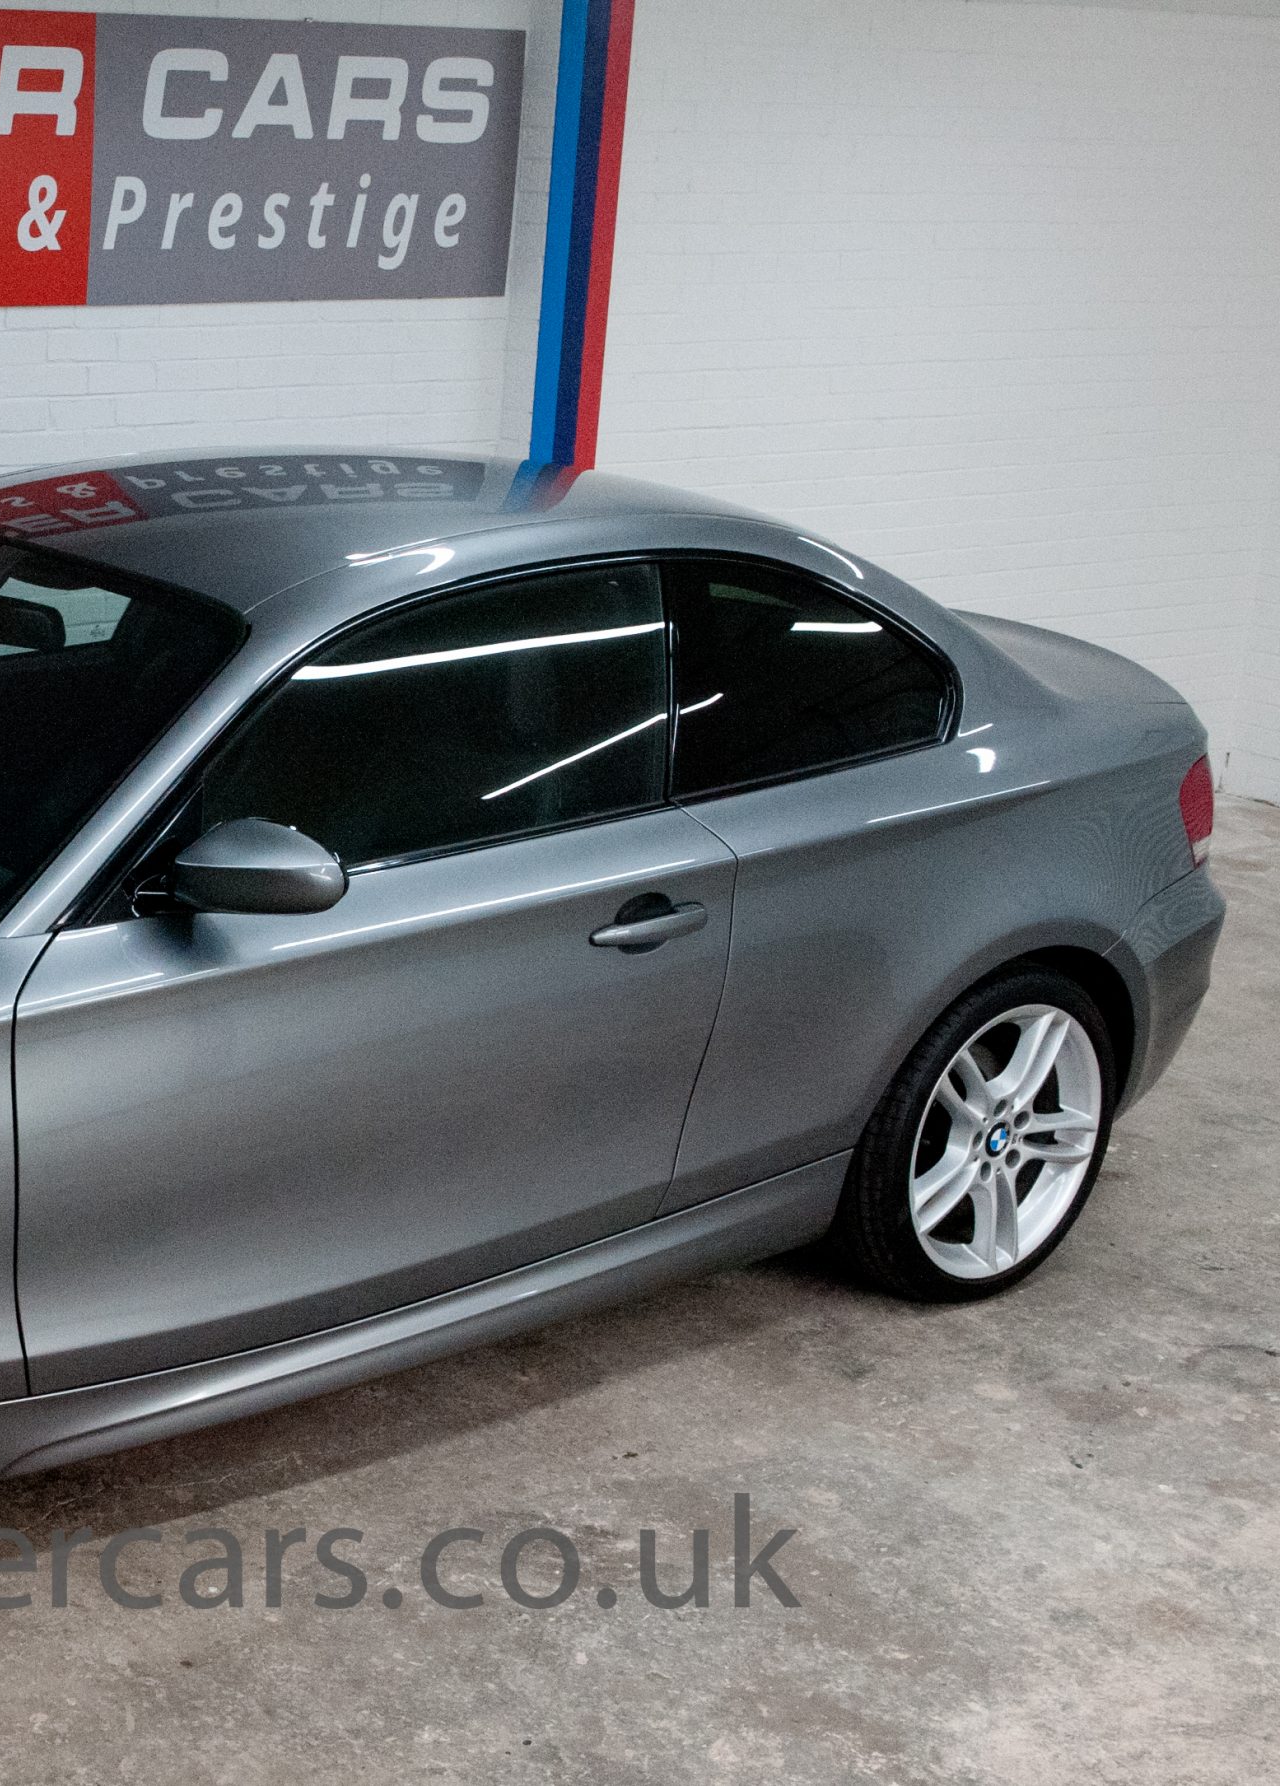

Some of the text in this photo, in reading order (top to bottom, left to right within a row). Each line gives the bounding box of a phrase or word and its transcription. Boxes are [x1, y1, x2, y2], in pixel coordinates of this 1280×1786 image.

[142, 48, 494, 144] CARS
[16, 174, 66, 252] &
[102, 174, 468, 270] Prestige
